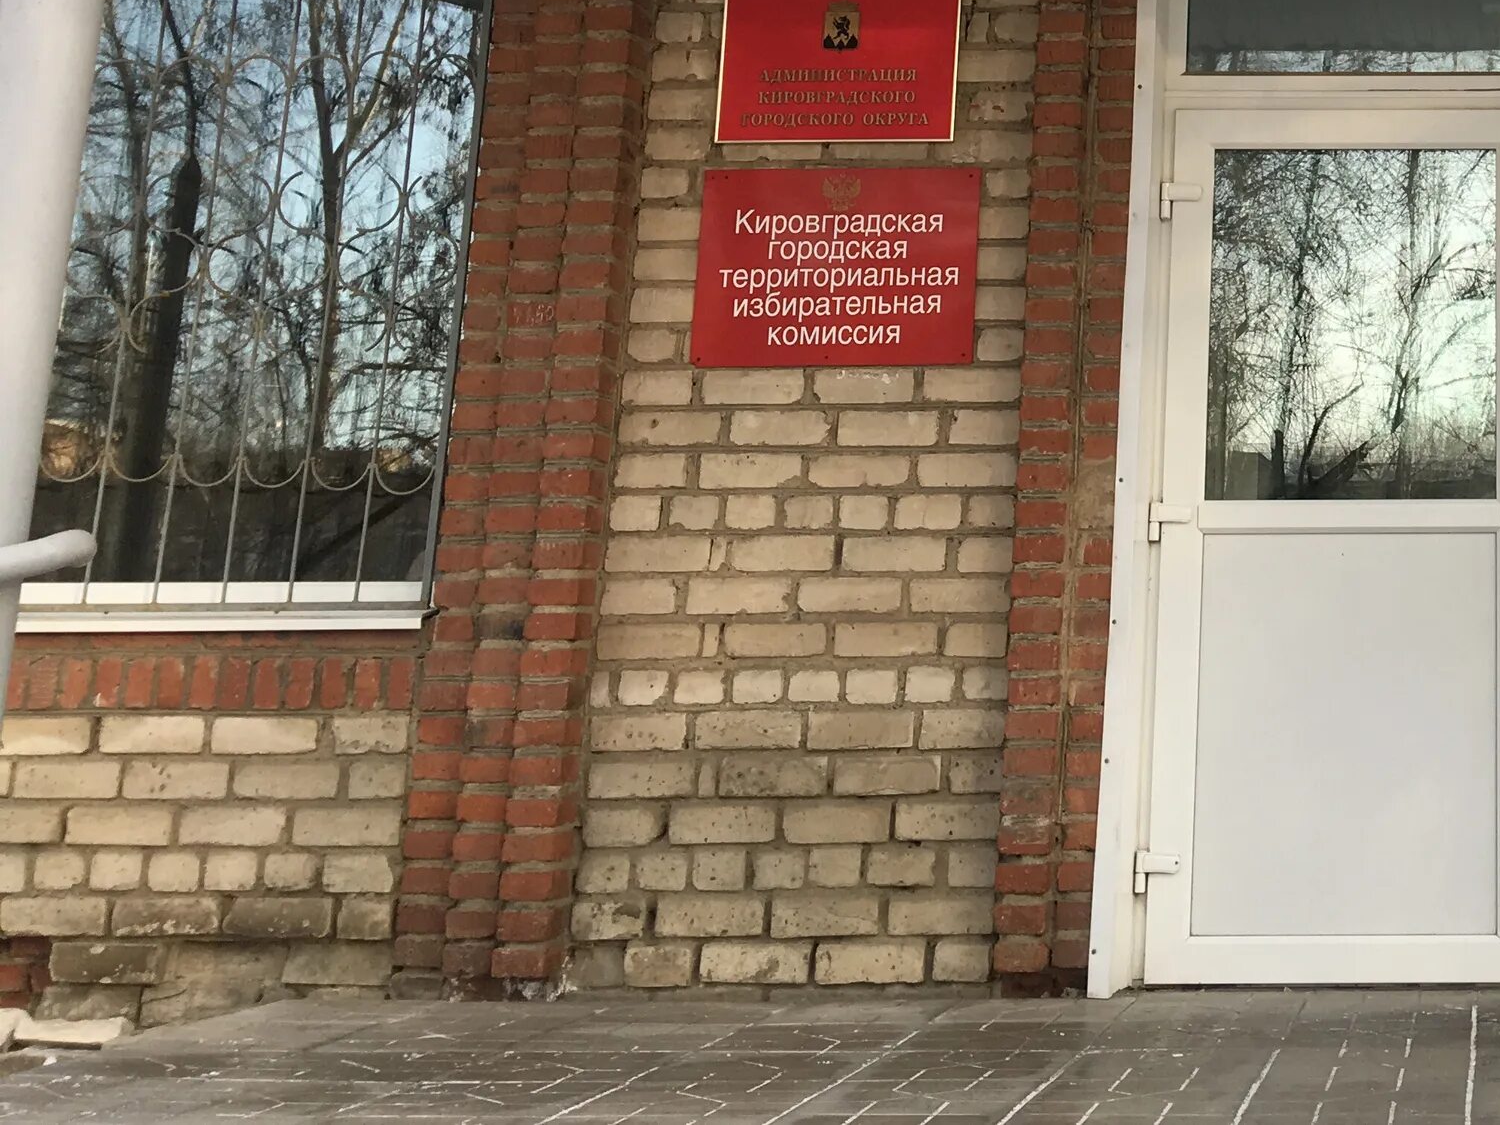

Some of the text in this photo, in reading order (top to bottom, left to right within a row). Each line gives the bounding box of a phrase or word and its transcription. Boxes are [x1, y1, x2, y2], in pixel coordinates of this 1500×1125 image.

[759, 68, 917, 84] АДМИНИСТРАЦИЯ
[758, 90, 916, 106] КИРОВГРАДСКОГО
[740, 112, 929, 127] ГОРОДСКОГО ОКРУГА
[735, 209, 943, 239] Кировградская
[767, 239, 908, 266] городская
[719, 265, 959, 294] территориальная
[733, 290, 942, 322] избирательная
[767, 324, 901, 346] комиссия
